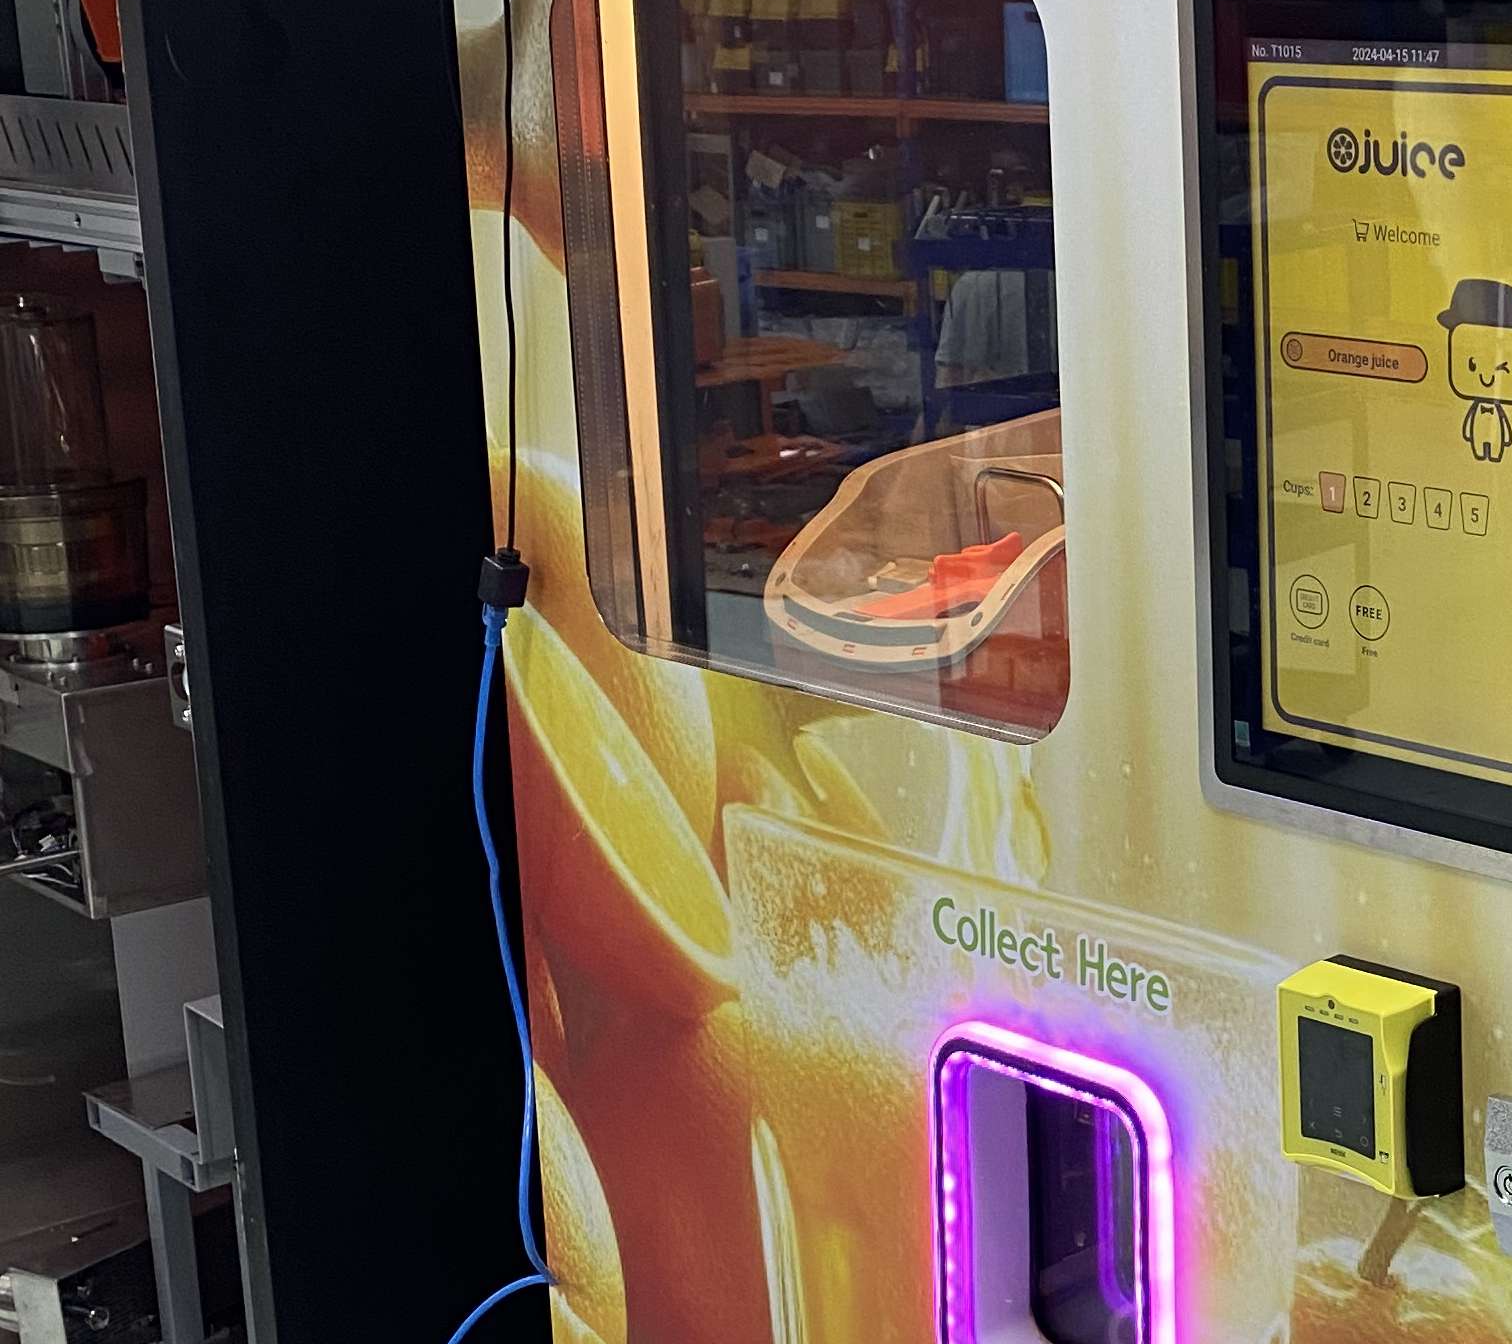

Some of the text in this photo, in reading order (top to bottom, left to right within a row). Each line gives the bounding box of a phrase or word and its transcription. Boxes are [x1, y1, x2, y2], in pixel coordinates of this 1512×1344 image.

[1251, 44, 1268, 57] No.
[1271, 44, 1302, 58] T1015
[1352, 47, 1409, 62] 2024-04-15
[1411, 49, 1440, 63] 11:47
[1373, 223, 1440, 246] Welcome
[1328, 348, 1399, 370] Orange juice
[1283, 479, 1479, 523] Cups: 1 2 3 4 5
[1355, 604, 1382, 620] FREE
[932, 897, 1169, 1012] Collect Here
